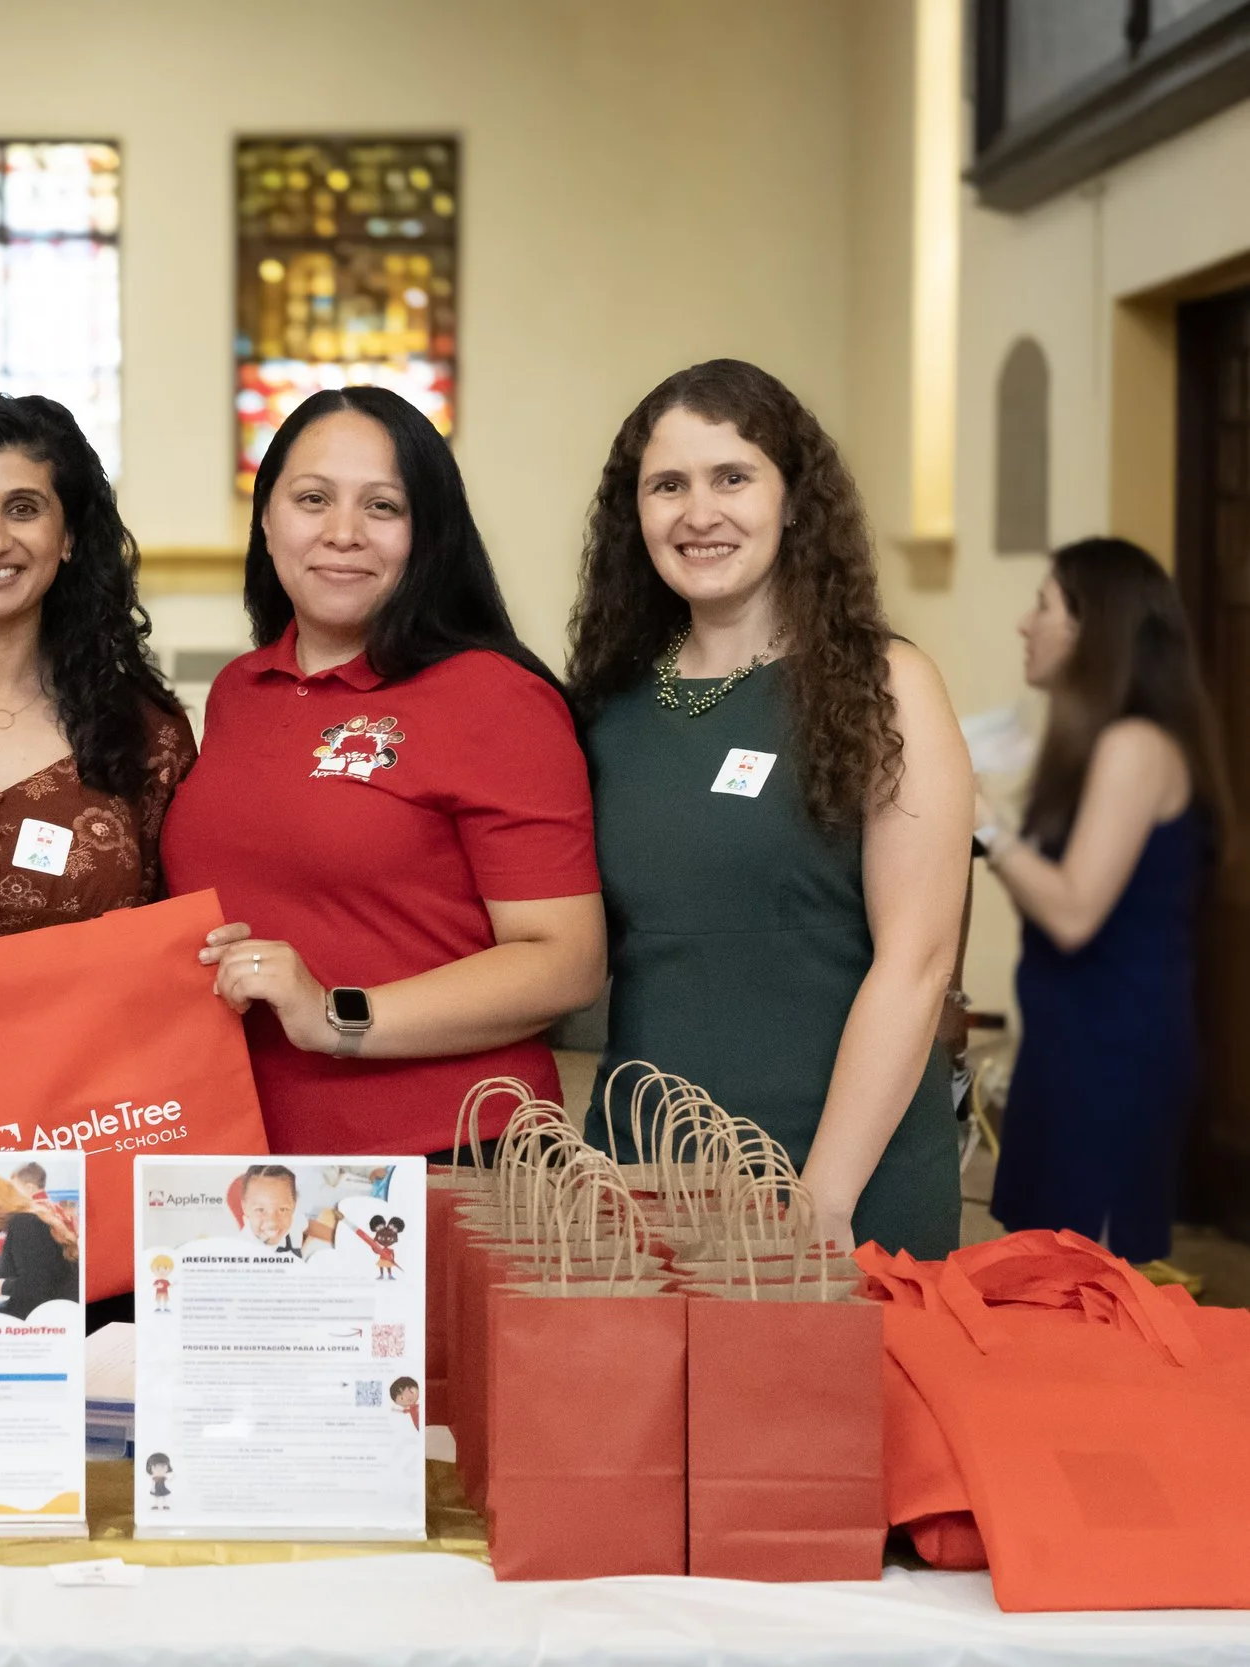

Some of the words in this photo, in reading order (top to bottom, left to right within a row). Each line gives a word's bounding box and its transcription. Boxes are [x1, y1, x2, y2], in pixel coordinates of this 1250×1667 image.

[32, 1100, 182, 1150] AppleTree
[114, 1125, 188, 1152] SCHOOLS
[166, 1193, 223, 1207] AppleTree
[5, 1326, 66, 1336] AppleTree
[182, 1344, 219, 1352] PROCESO
[221, 1344, 231, 1352] DE
